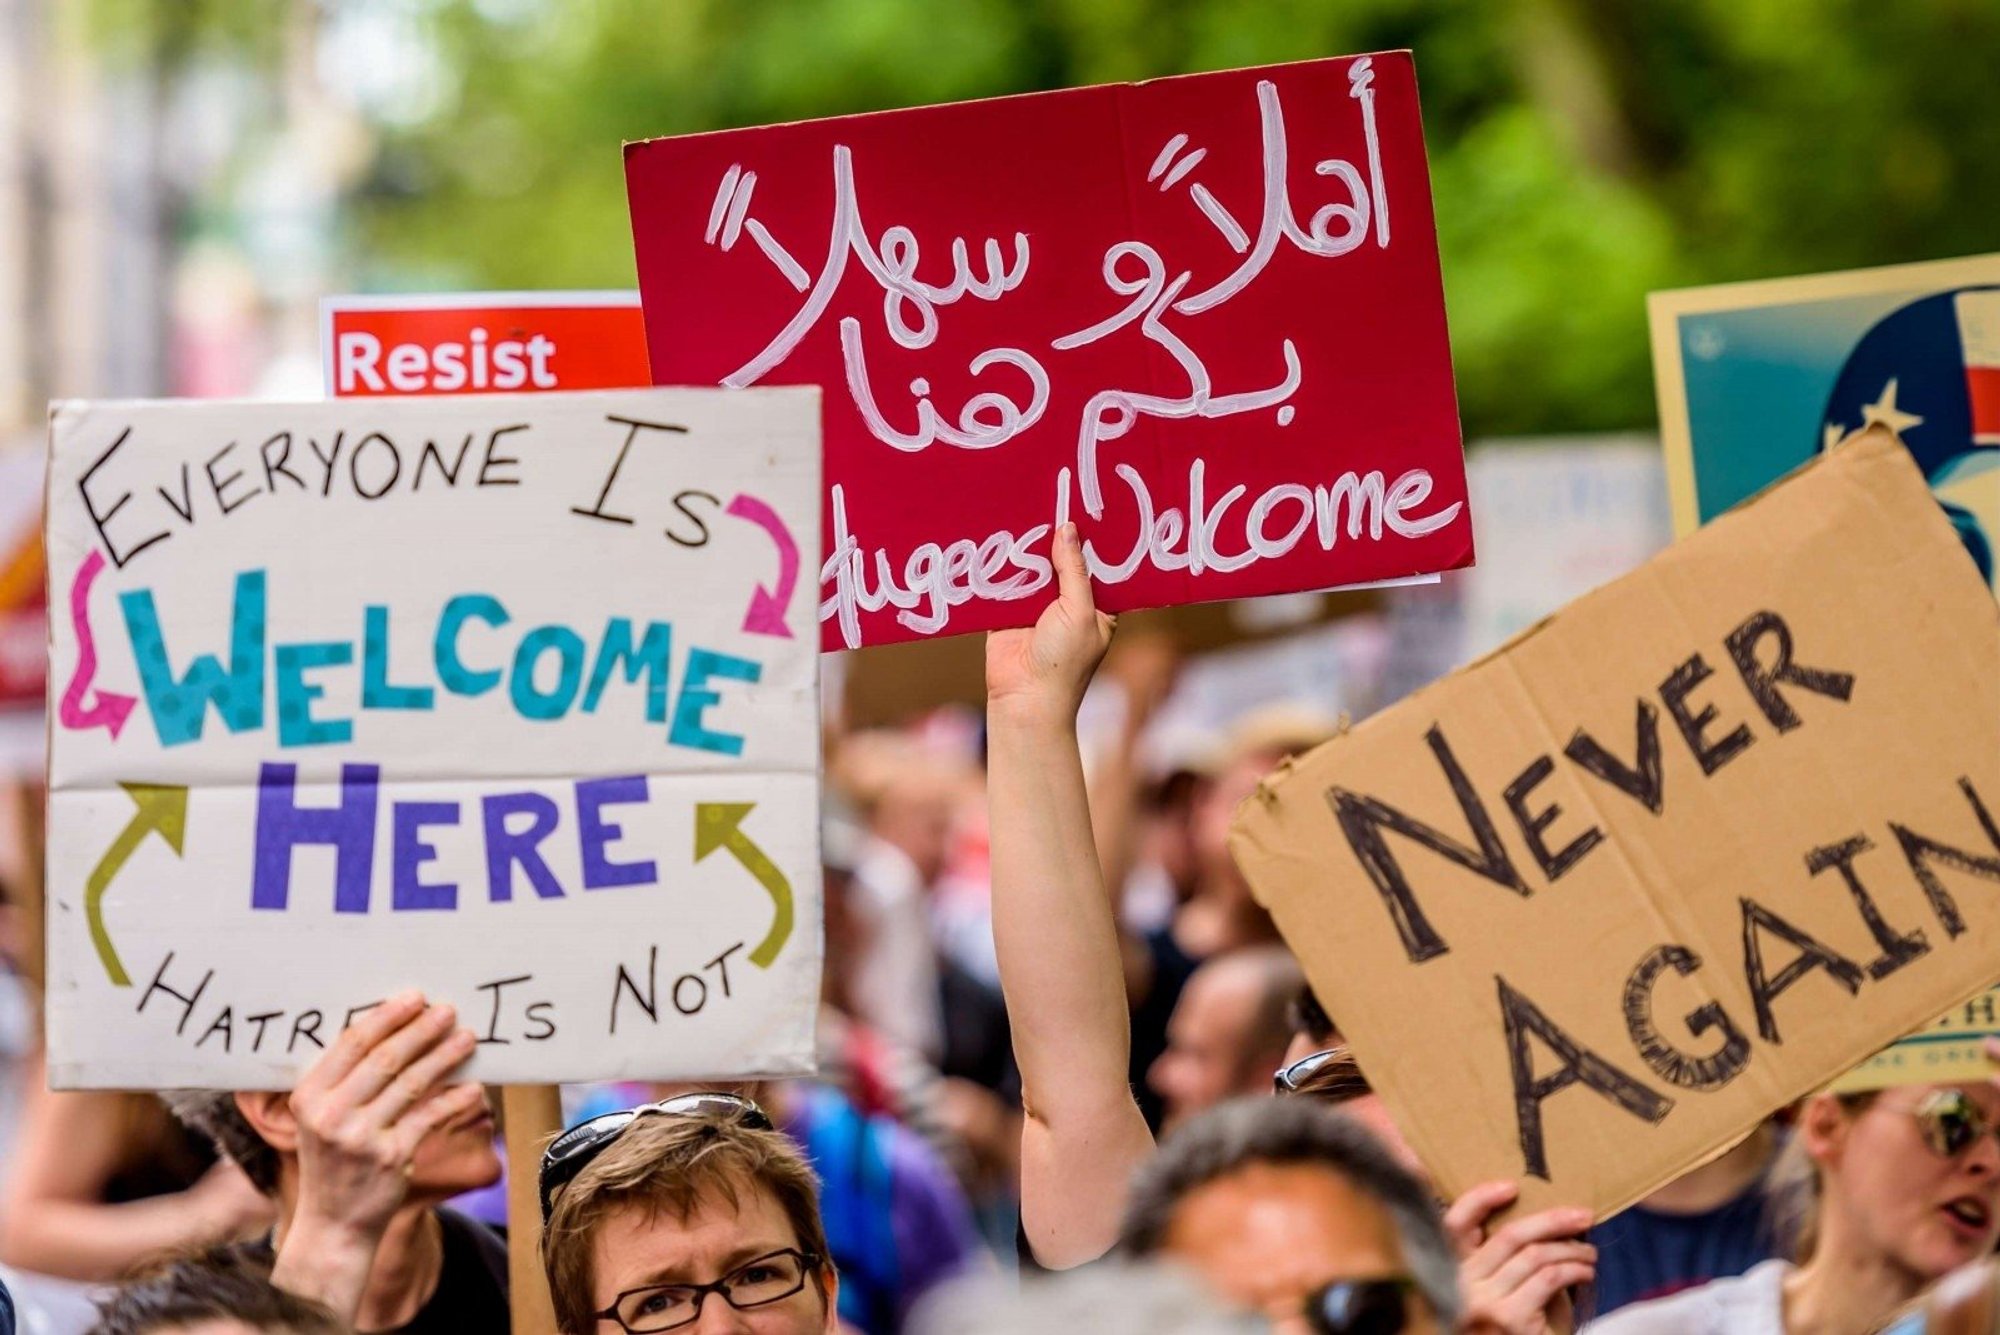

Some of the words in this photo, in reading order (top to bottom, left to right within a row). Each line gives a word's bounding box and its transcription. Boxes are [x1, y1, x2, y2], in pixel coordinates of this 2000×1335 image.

[338, 326, 558, 393] Resist
[839, 316, 1050, 452] هنا
[1078, 270, 1302, 521] بكم
[77, 425, 532, 569] EVERYONE
[571, 415, 723, 548] IS
[820, 483, 1051, 649] fugees
[1055, 457, 1463, 584] Welcome
[118, 568, 763, 756] WELCOME
[250, 761, 658, 914] HERE
[1325, 610, 1856, 964] NEVER
[136, 950, 430, 1053] HATR
[475, 974, 557, 1045] IS
[608, 943, 745, 1034] NOT
[1493, 774, 2000, 1182] AGAIN
